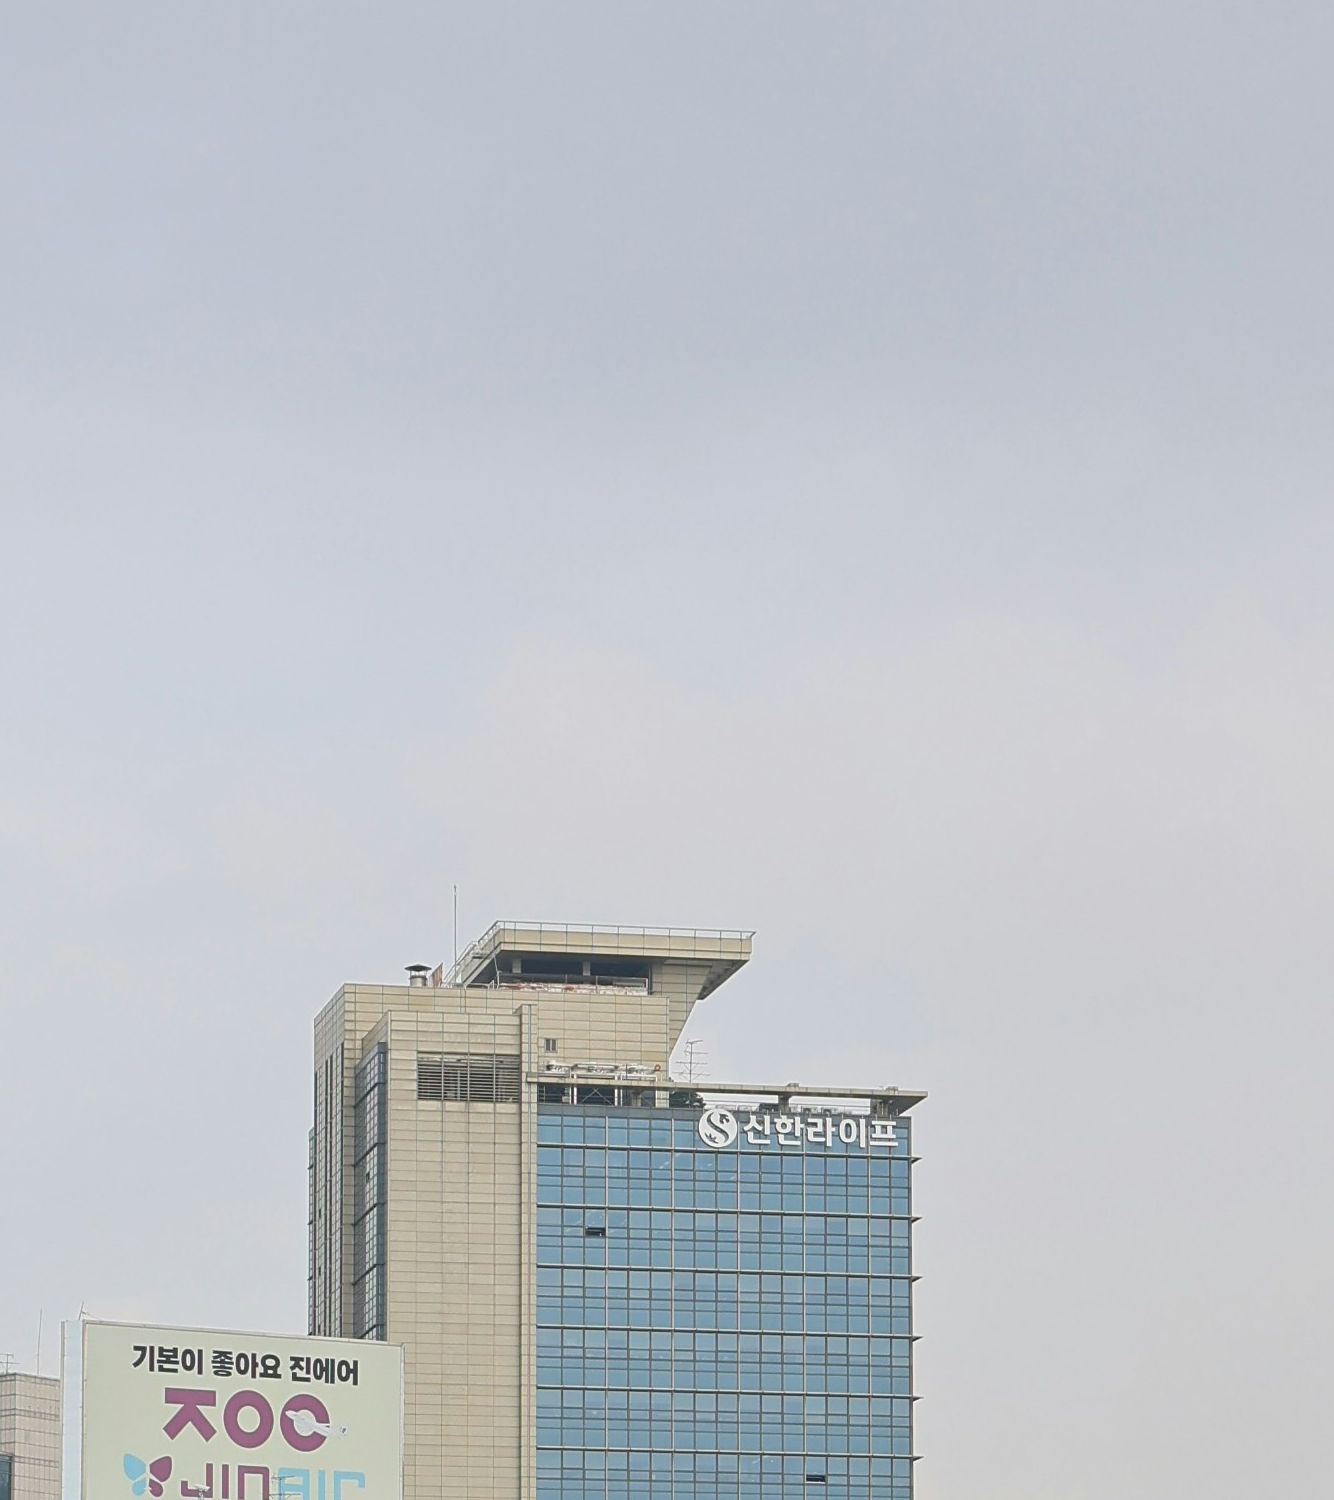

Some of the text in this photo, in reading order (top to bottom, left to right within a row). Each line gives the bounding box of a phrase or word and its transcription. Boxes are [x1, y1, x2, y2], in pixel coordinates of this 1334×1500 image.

[743, 1114, 899, 1148] 신한라이프
[132, 1345, 359, 1386] 기본이 좋아요 진에어
